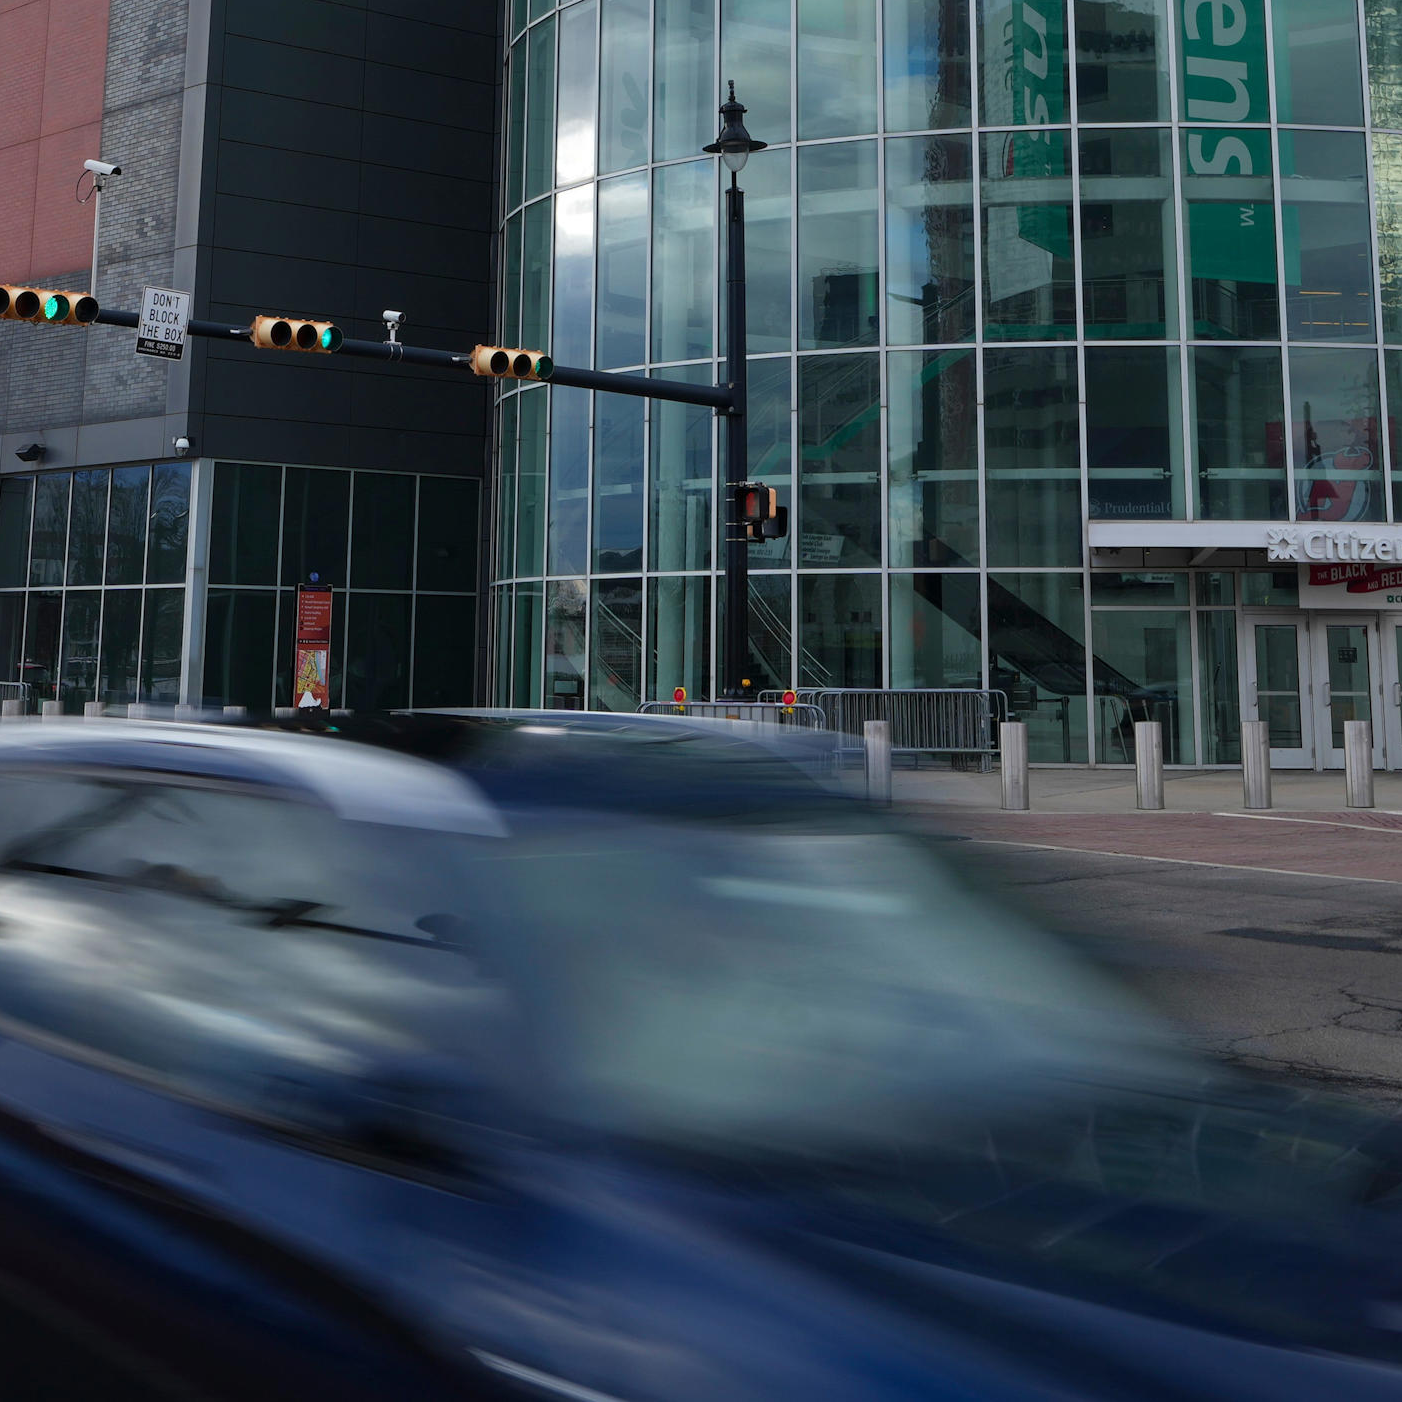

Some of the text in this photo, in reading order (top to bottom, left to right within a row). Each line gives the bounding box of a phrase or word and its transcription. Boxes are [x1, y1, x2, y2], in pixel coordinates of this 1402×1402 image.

[153, 293, 181, 309] DON'T
[149, 309, 180, 326] BLOCK
[142, 323, 184, 343] THE BOX
[1104, 501, 1165, 514] Prudential
[1317, 562, 1368, 581] THE BLACK
[1367, 580, 1379, 591] AND
